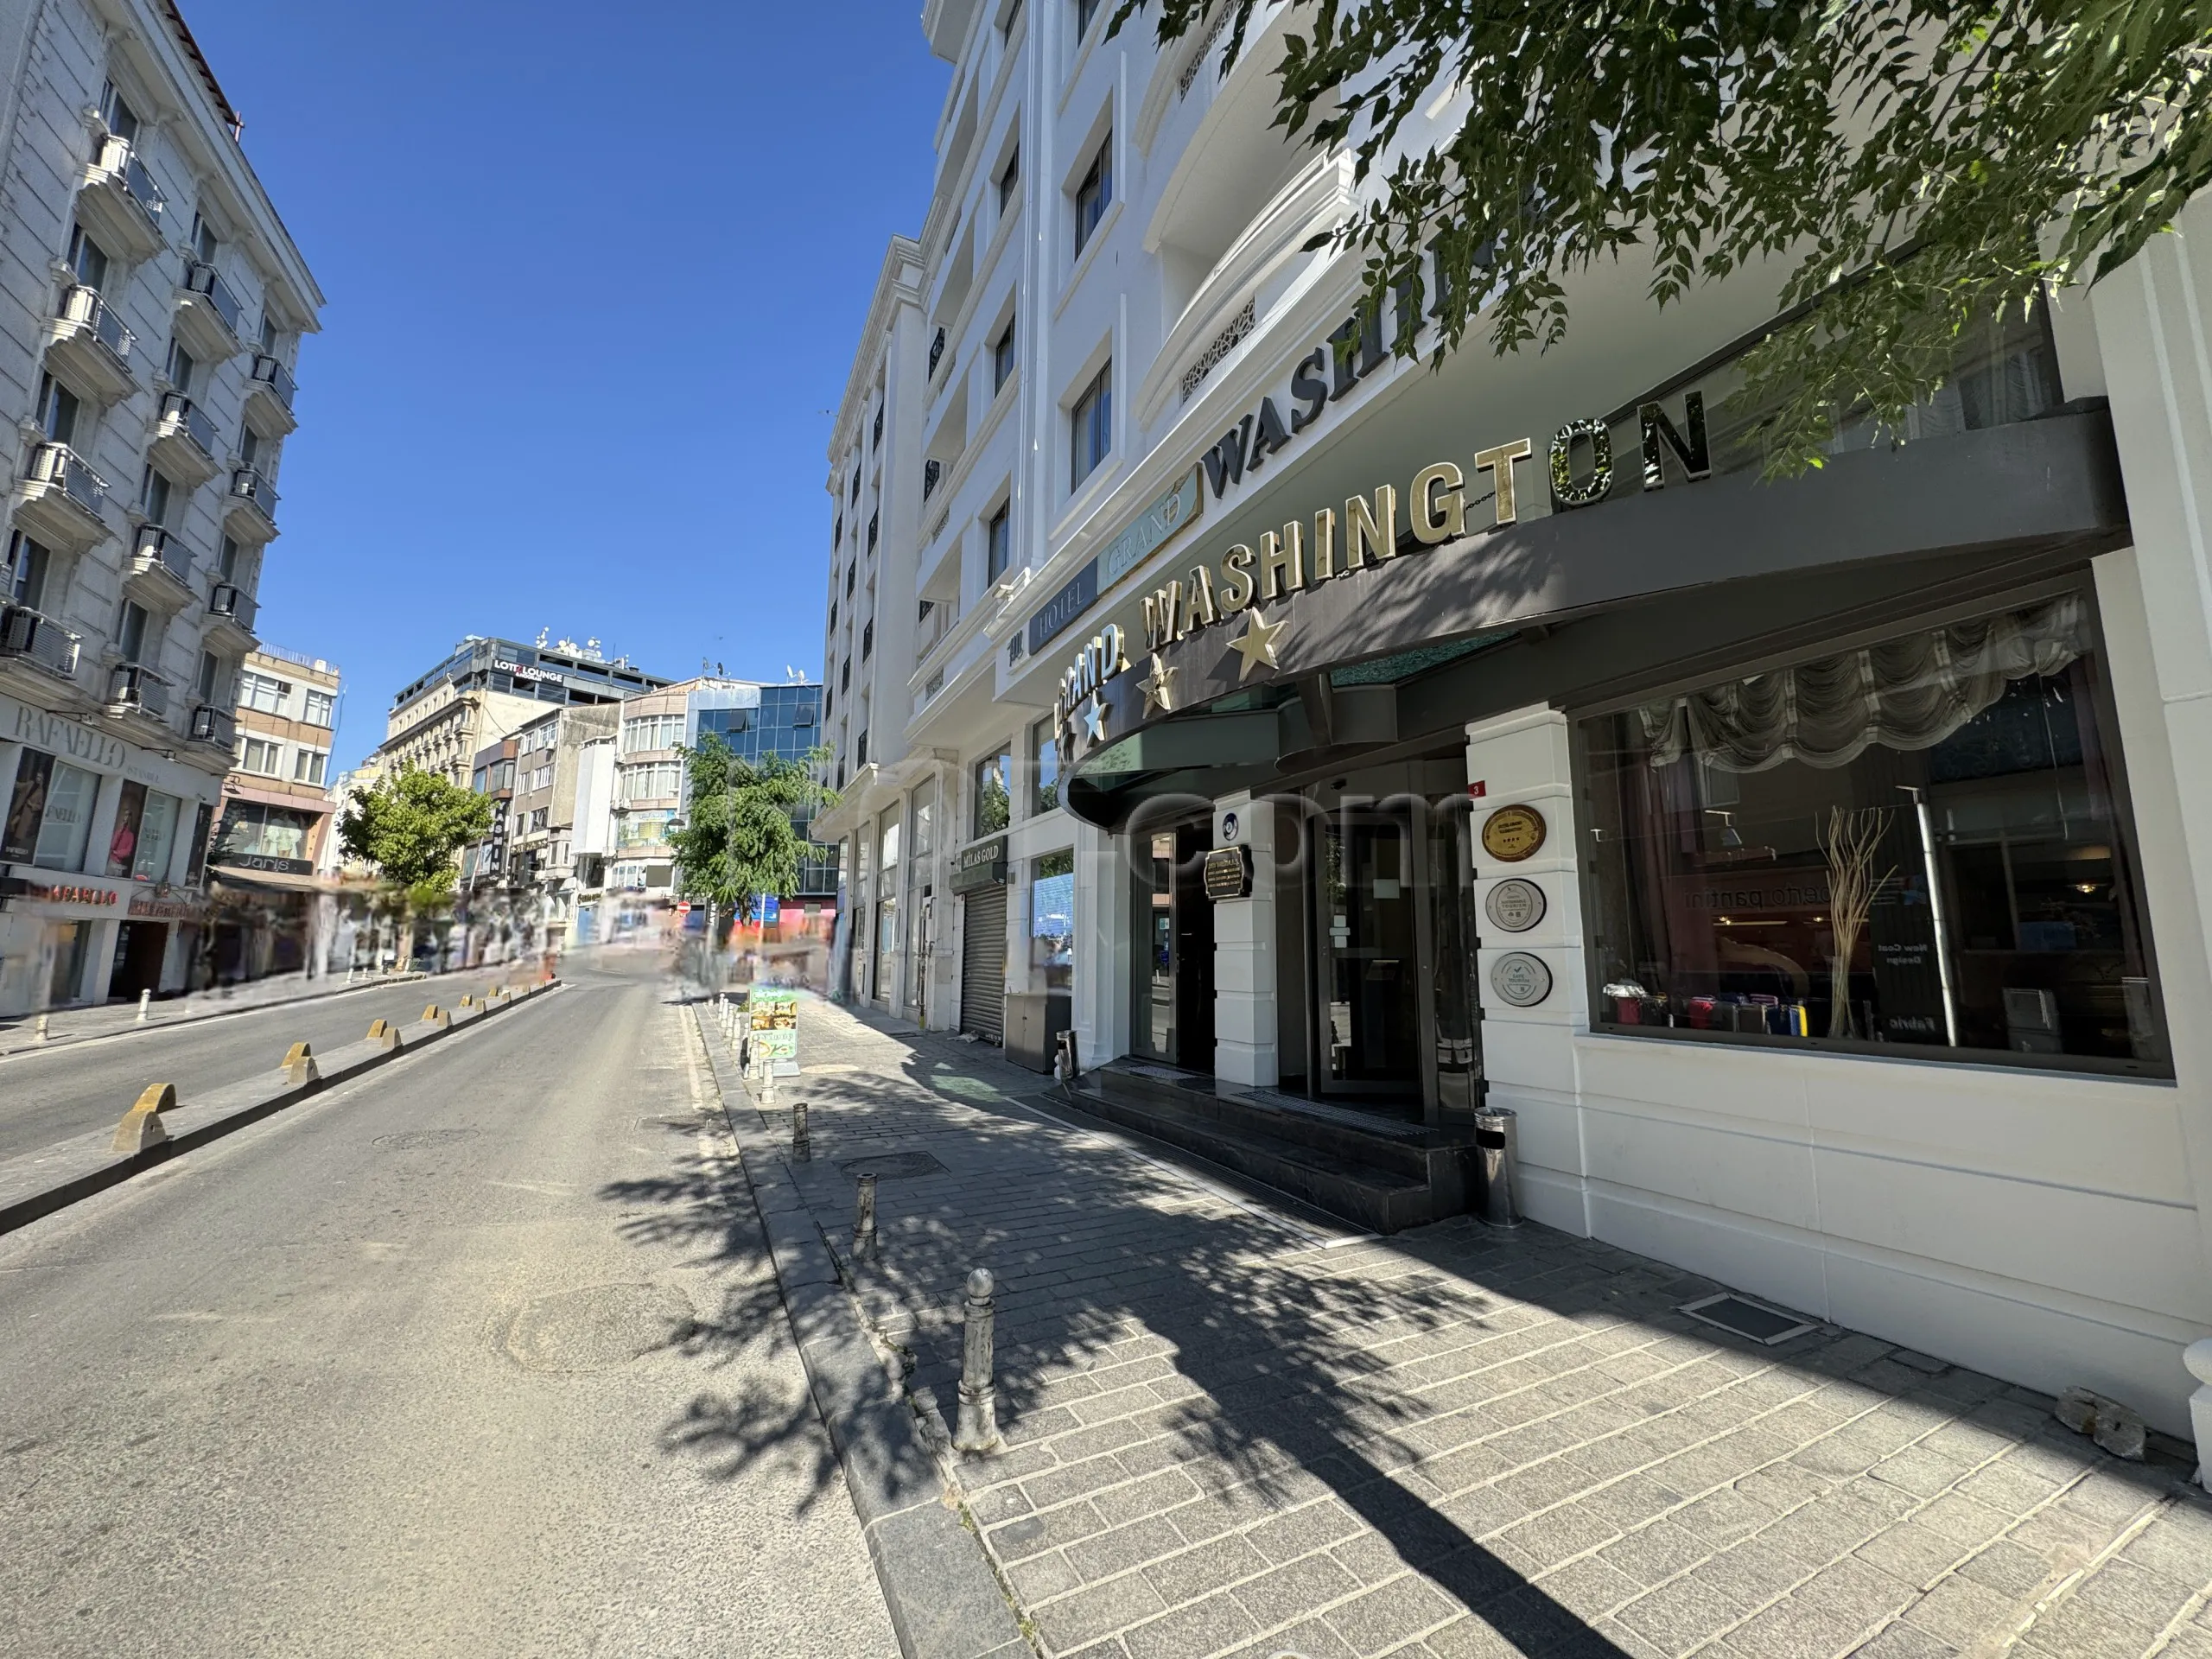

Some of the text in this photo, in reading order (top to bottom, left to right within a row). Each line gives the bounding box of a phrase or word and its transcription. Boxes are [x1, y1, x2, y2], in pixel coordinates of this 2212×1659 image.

[1139, 390, 1712, 654] WASHINGTON
[1039, 581, 1085, 639] HOTEL
[1108, 493, 1182, 575] GRAND
[522, 666, 563, 683] LOUNGE
[14, 705, 126, 770] RAFAELLO
[1473, 785, 1479, 795] 3
[491, 801, 506, 871] YASMIN
[981, 845, 999, 863] GOLD
[43, 883, 119, 906] AFAELLO
